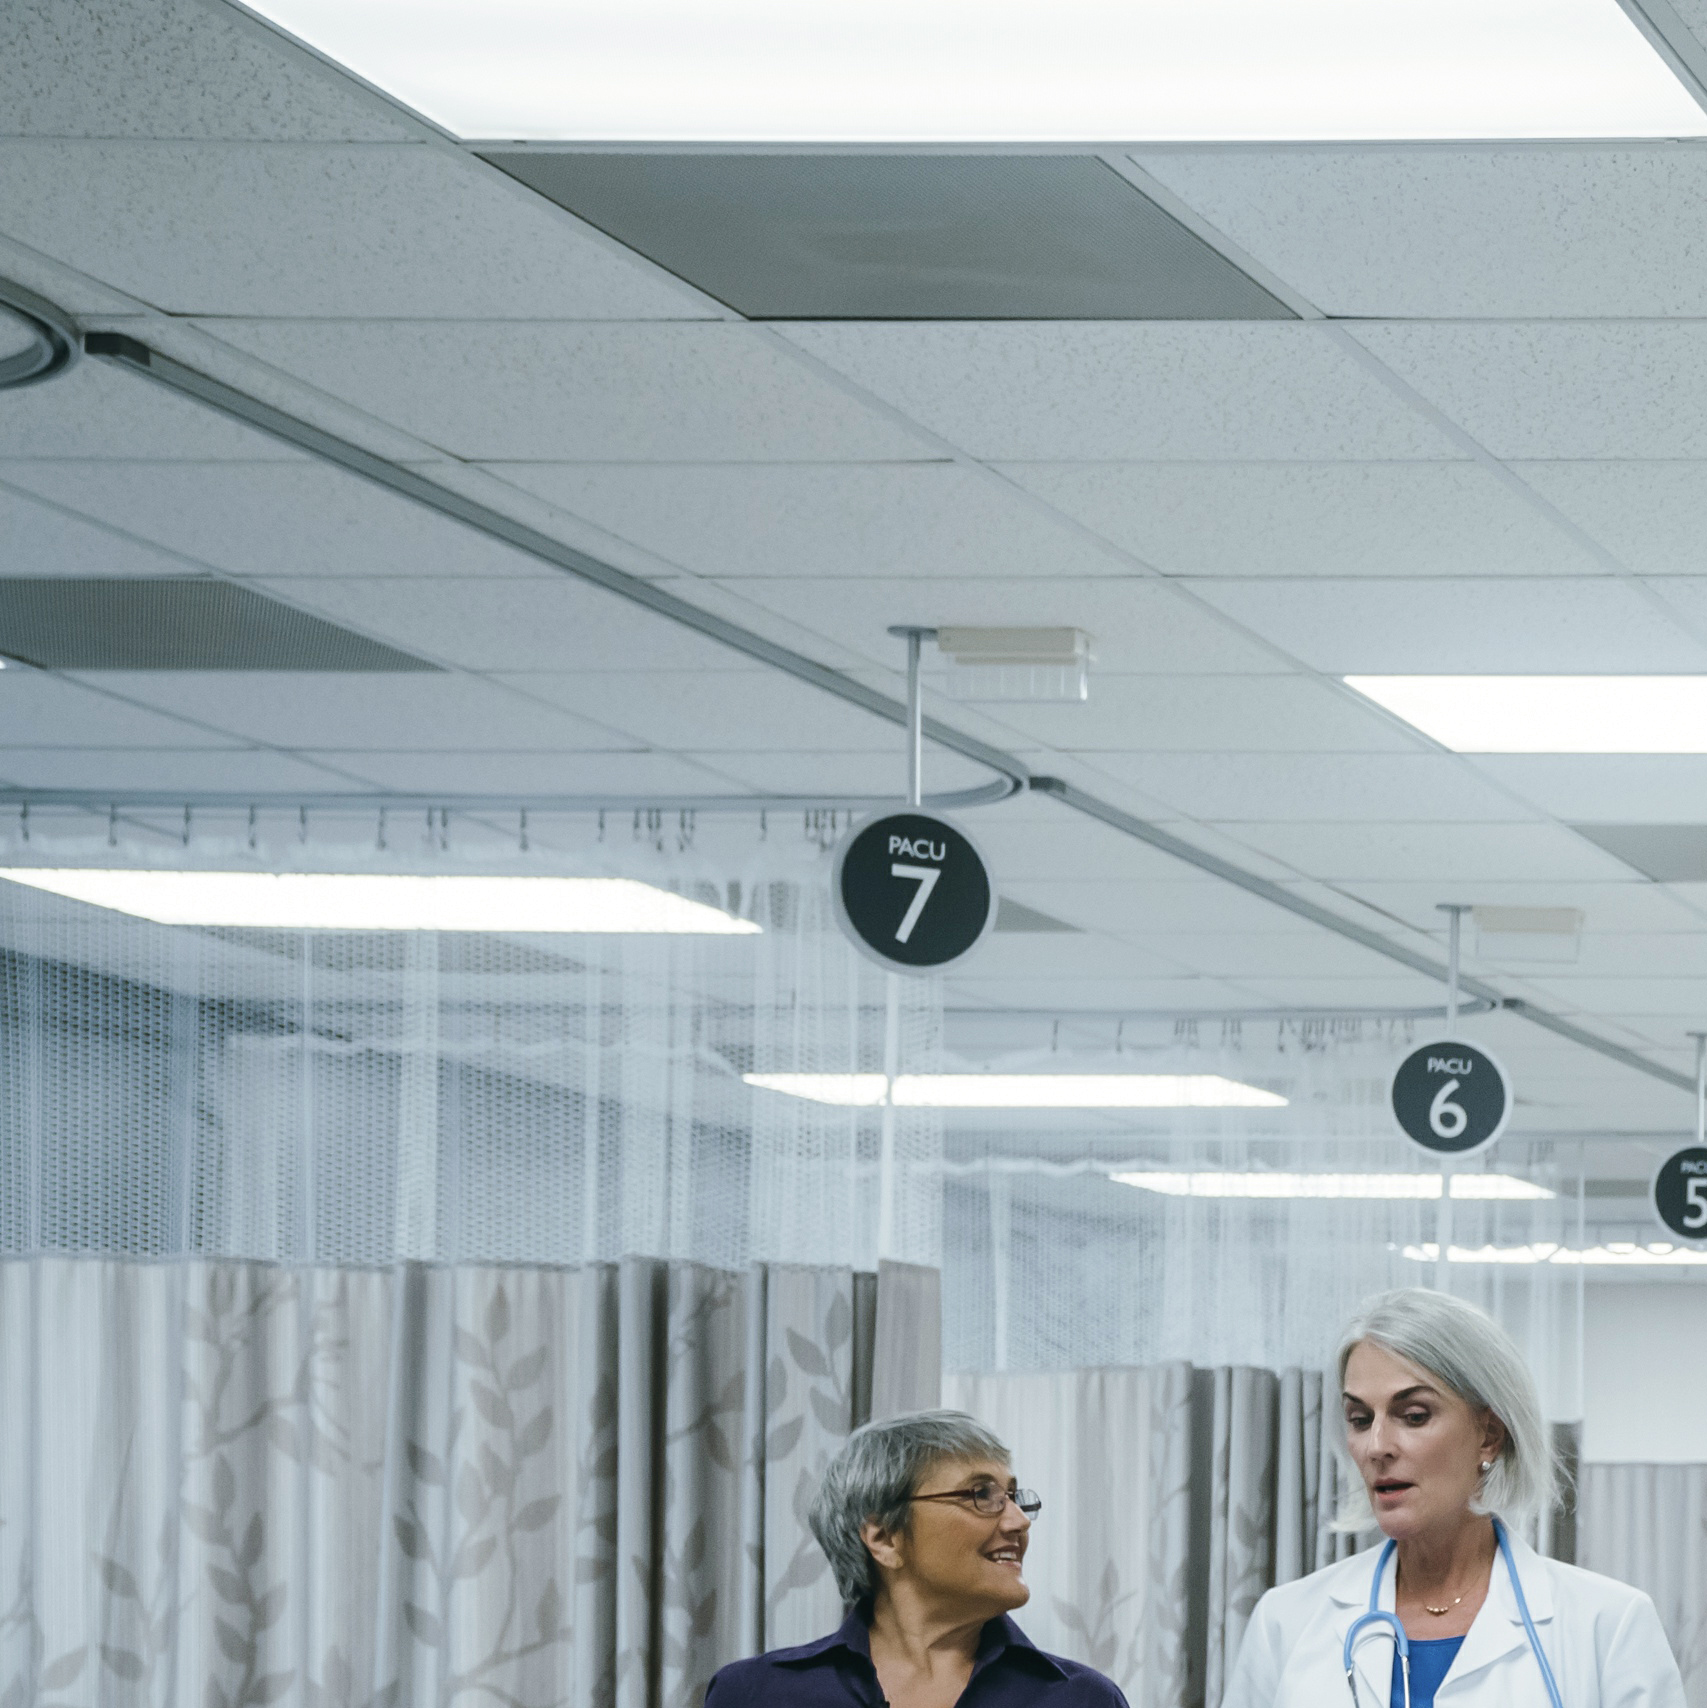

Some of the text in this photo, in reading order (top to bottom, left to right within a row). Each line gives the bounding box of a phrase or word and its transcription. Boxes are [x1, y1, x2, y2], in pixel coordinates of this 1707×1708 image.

[887, 836, 947, 863] PACU
[890, 864, 942, 944] 7
[1426, 1056, 1474, 1076] PACU
[1428, 1078, 1469, 1140] 6
